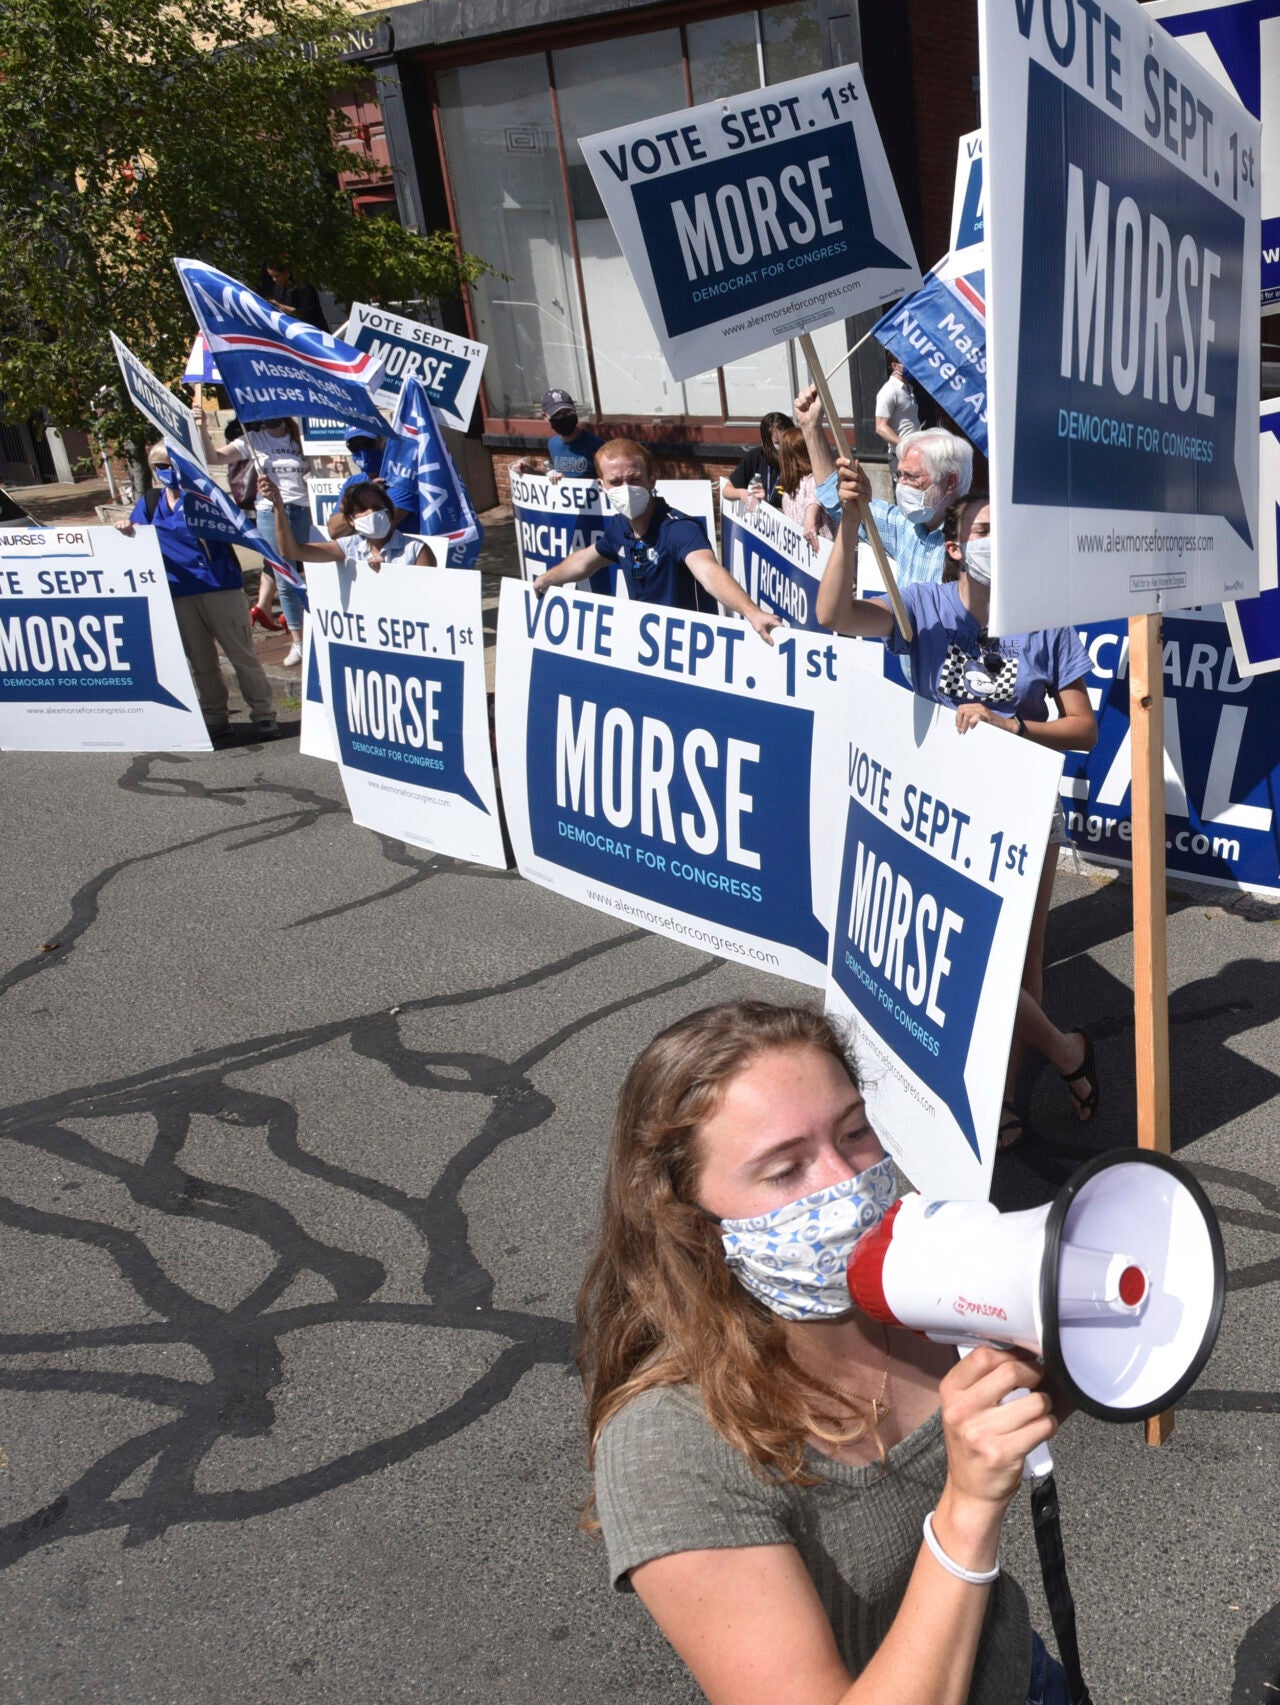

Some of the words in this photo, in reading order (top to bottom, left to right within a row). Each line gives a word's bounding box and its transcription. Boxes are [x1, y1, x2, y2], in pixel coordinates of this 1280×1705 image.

[600, 125, 708, 182] VOTE
[721, 97, 815, 150] SEPT.
[822, 81, 859, 120] 1st
[1143, 54, 1219, 187] SEPT.
[1230, 132, 1254, 201] 1st
[670, 155, 843, 281] MORSE
[692, 271, 758, 303] DEMOCRAT
[761, 264, 785, 280] FOR
[787, 241, 848, 270] CONGRESS
[1060, 162, 1221, 417] MORSE
[358, 309, 403, 335] VOTE
[412, 328, 455, 354] SEPT.
[721, 280, 861, 337] www.alexmorseforcongress.com
[369, 339, 452, 391] MORSE
[893, 310, 966, 391] Nurses
[234, 386, 304, 404] Nurses
[1057, 409, 1133, 448] DEMOCRAT
[1137, 426, 1159, 452] FOR
[1162, 432, 1214, 463] CONGRESS
[311, 484, 332, 493] VOTE
[0, 535, 46, 546] NURSES
[57, 533, 84, 544] FOR
[188, 517, 236, 534] urses
[1077, 528, 1214, 557] www.alexmorseforcongress.com
[38, 570, 115, 594] SEPT.
[124, 569, 157, 593] 1st
[760, 559, 808, 625] RICHARD
[0, 615, 131, 673] MORSE
[317, 608, 367, 643] VOTE
[377, 617, 438, 654] SEPT.
[446, 625, 474, 655] 1st
[524, 590, 614, 657] VOTE
[638, 613, 756, 689] SEPT.
[778, 638, 838, 697] 1st
[3, 678, 56, 687] DEMOCRAT
[58, 677, 78, 686] FOR
[80, 677, 133, 687] CONGRESS
[344, 666, 443, 752] MORSE
[352, 740, 387, 758] DEMOCRAT
[388, 749, 402, 762] FOR
[404, 752, 445, 771] CONGRESS
[556, 693, 762, 870] MORSE
[848, 740, 892, 816] VOTE
[901, 784, 971, 869] SEPT.
[989, 830, 1028, 883] 1st
[558, 820, 632, 860] DEMOCRAT
[636, 848, 666, 872] FOR
[671, 861, 763, 903] CONGRESS
[586, 888, 779, 967] www.alexmorseforcongress.com
[847, 840, 964, 1029] MORSE
[845, 951, 878, 997] DEMOCRAT
[878, 988, 893, 1014] FOR
[894, 1005, 940, 1057] CONGRESS
